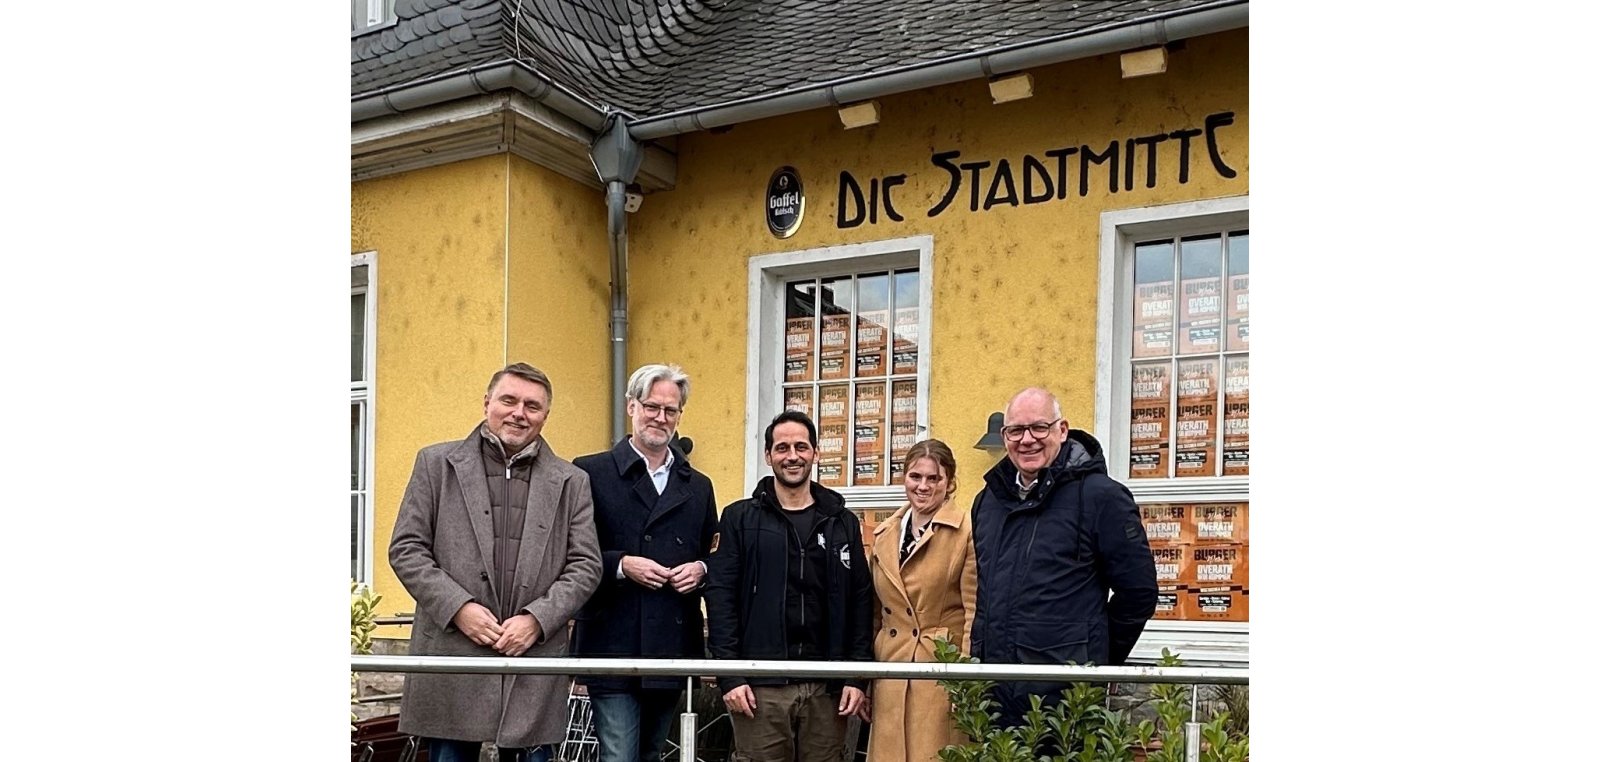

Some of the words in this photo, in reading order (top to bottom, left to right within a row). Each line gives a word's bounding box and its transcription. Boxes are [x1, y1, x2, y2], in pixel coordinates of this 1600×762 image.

[837, 170, 907, 229] DIE
[928, 111, 1237, 218] STADTMITTE
[770, 192, 799, 208] Gaffel
[1194, 549, 1236, 561] BURGER
